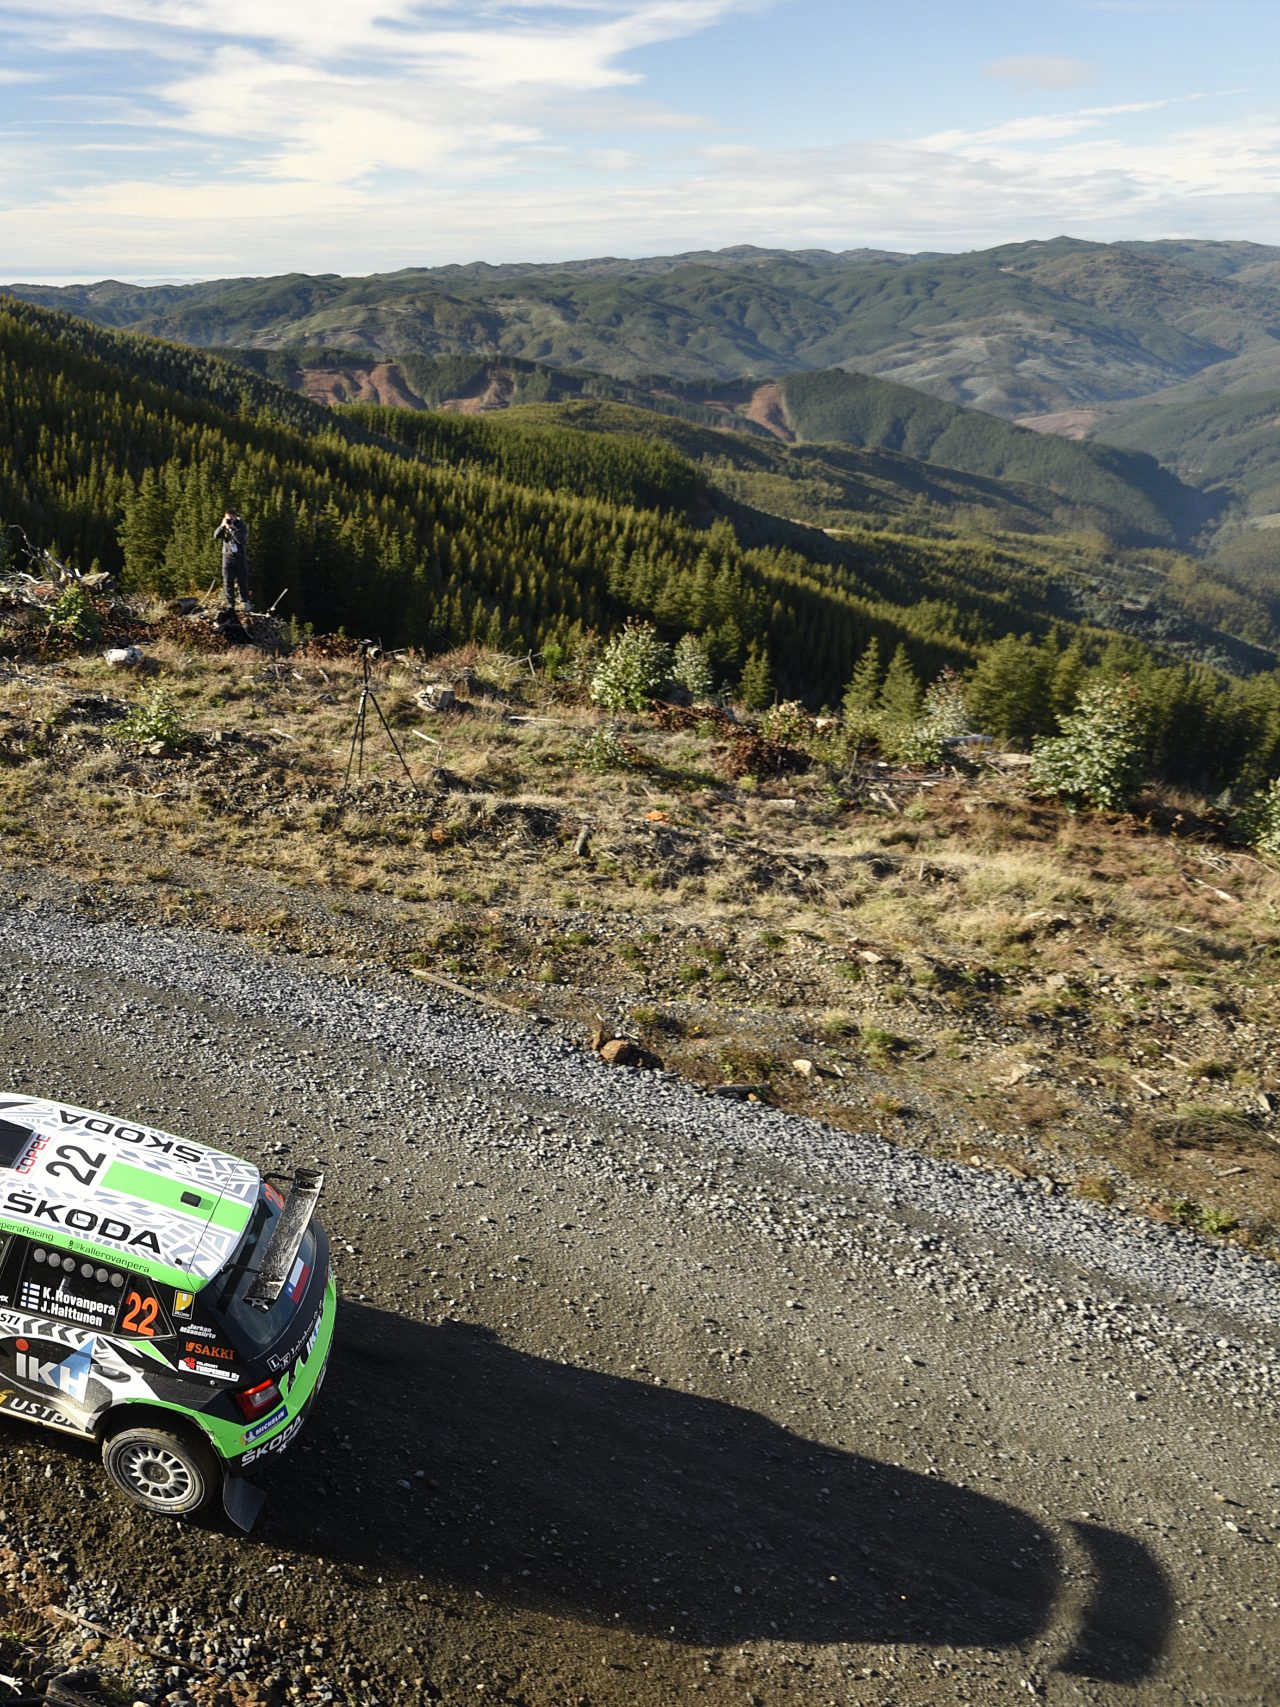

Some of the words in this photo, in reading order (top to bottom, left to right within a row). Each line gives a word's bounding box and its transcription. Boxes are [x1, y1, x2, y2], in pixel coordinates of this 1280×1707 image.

[45, 1144, 107, 1186] 22
[3, 1189, 161, 1254] ŠKODA
[40, 1301, 103, 1327] J.Halttunen
[121, 1291, 158, 1337] 22
[195, 1343, 234, 1360] SAKKI
[241, 1415, 301, 1467] ŠKODA
[255, 1411, 285, 1436] MICHELIN
